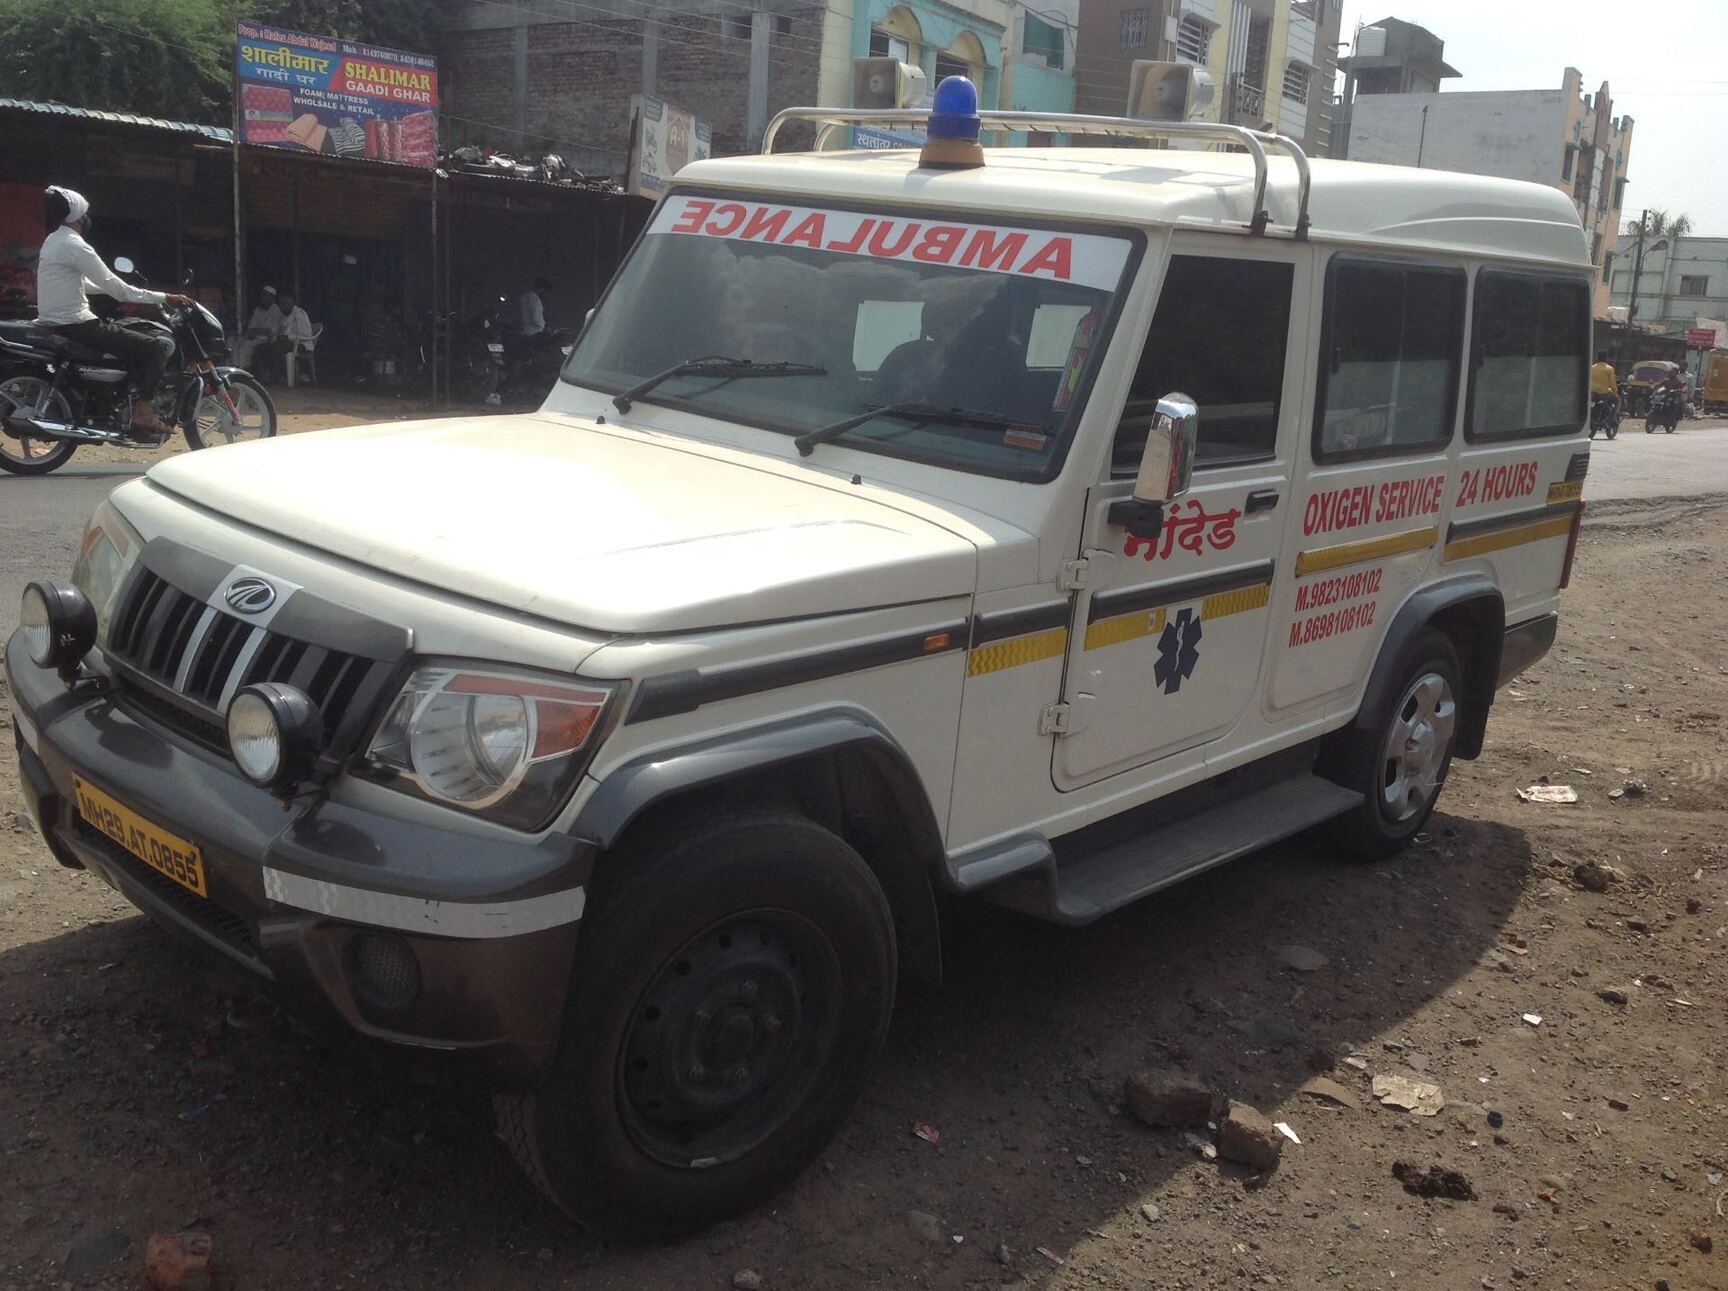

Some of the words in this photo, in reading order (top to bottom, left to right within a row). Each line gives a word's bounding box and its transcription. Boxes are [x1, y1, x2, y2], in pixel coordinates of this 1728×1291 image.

[240, 45, 330, 75] शालीमार
[255, 66, 290, 82] गादी
[295, 74, 316, 86] घर
[344, 61, 432, 91] SHALIMAR
[293, 96, 338, 110] WHOLSALE
[347, 105, 375, 116] RETAIL
[326, 92, 369, 105] MATTRESS
[346, 80, 389, 97] GAADI
[393, 89, 431, 103] GHAR
[1455, 467, 1481, 508] 24
[1481, 461, 1538, 502] HOURS
[1303, 483, 1375, 536] OXIGEN
[1375, 475, 1445, 523] SERVICE
[1295, 568, 1383, 613] M.9823108102
[1288, 601, 1376, 648] M.8698108102
